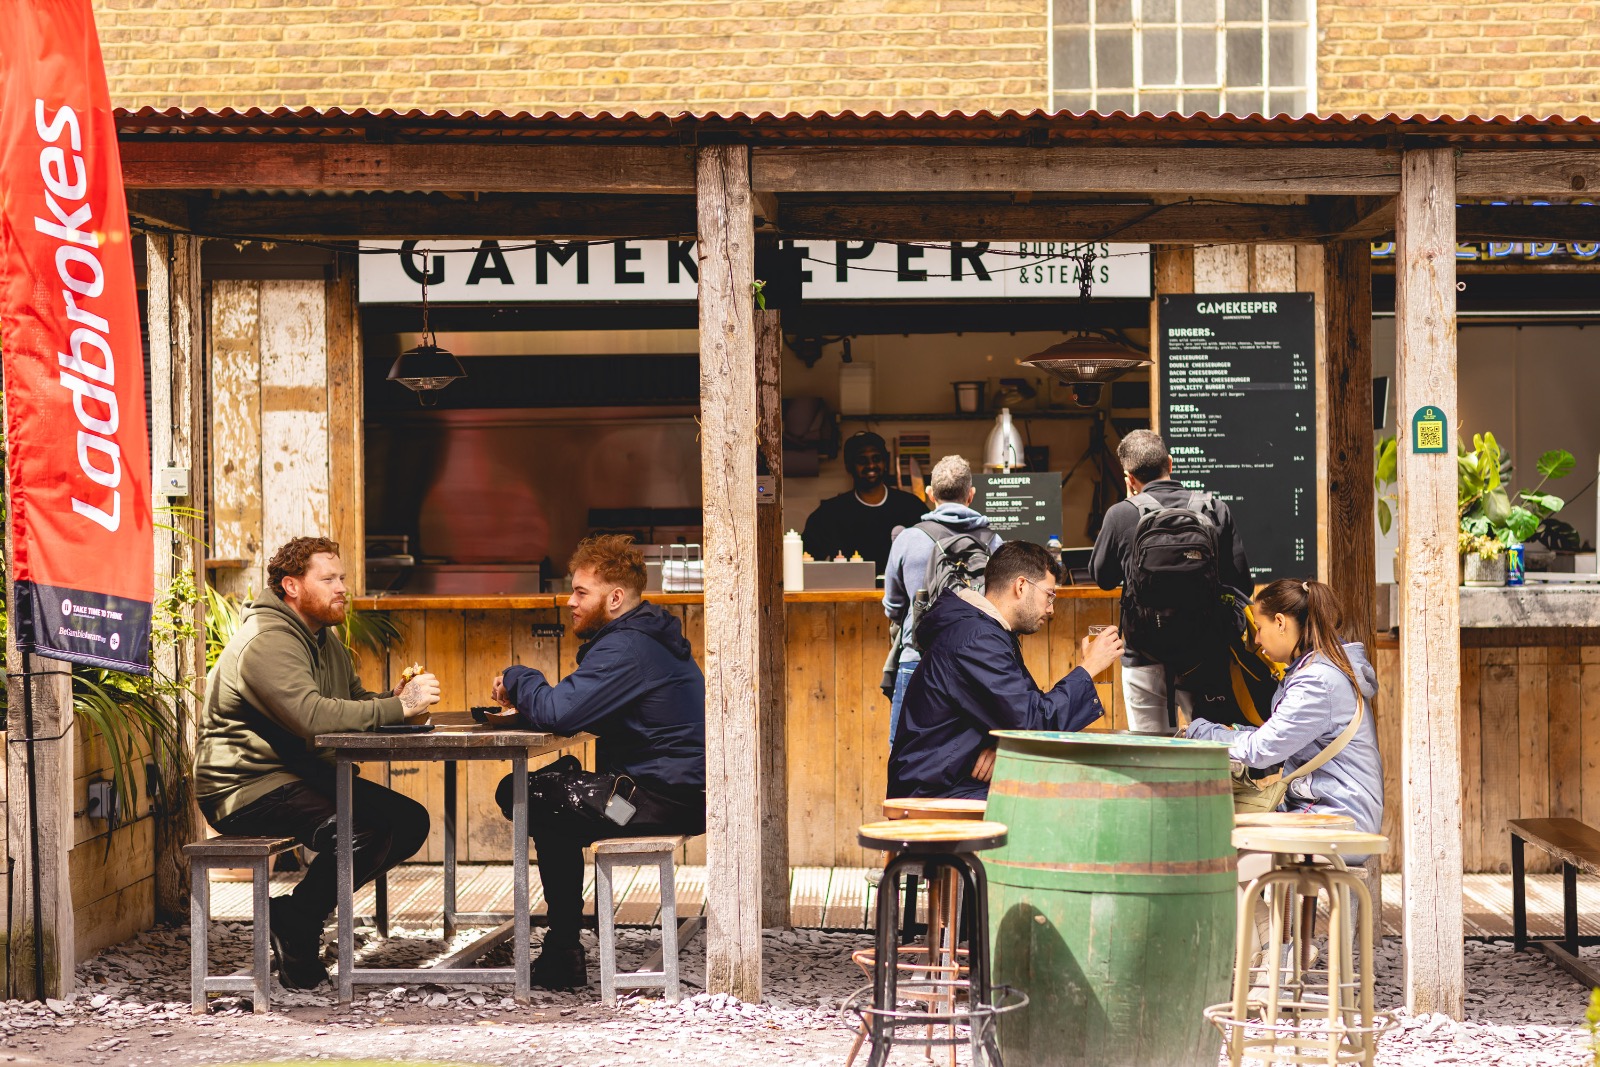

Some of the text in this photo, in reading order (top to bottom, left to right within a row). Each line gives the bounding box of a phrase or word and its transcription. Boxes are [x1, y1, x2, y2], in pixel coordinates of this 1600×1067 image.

[1019, 242, 1109, 259] BURGERS
[400, 238, 993, 285] GAMEKPER
[34, 98, 121, 532] Ladbrokes
[1197, 301, 1277, 314] GAMEKEEPER
[72, 604, 88, 614] TAKE
[88, 607, 101, 616] TIME
[107, 610, 123, 620] THINK
